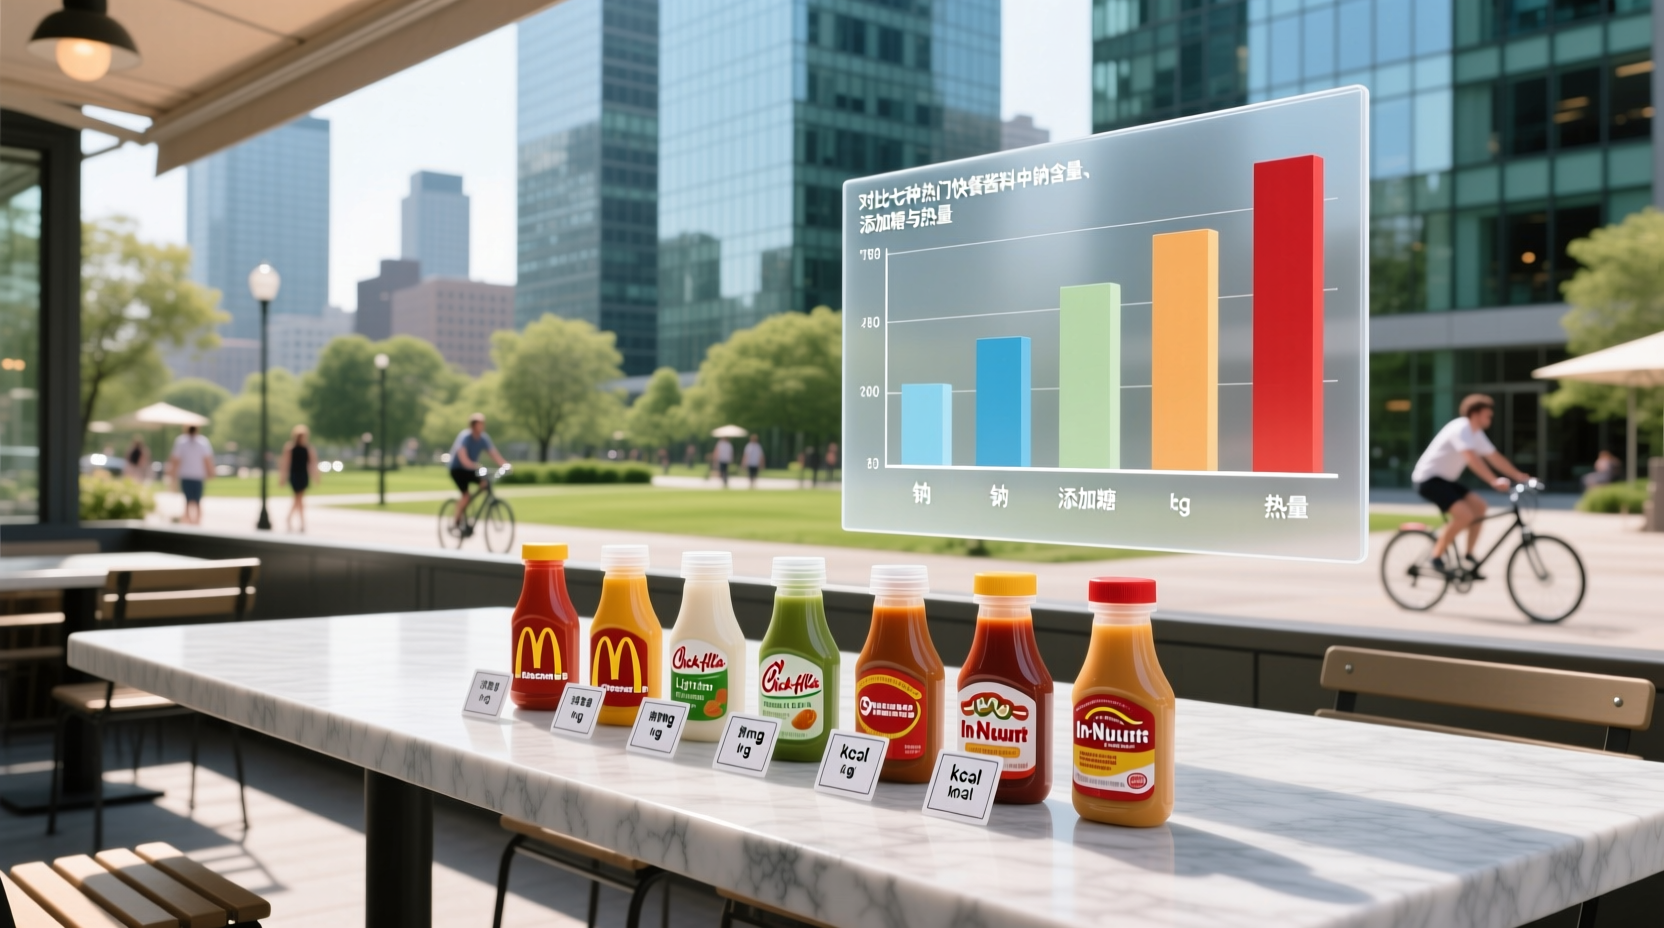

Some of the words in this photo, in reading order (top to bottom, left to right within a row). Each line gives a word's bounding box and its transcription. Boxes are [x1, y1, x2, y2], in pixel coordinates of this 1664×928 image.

[859, 385, 880, 398] 200
[1058, 486, 1117, 512] 添加糖
[1264, 493, 1310, 520] 热量
[949, 763, 983, 786] kcal
